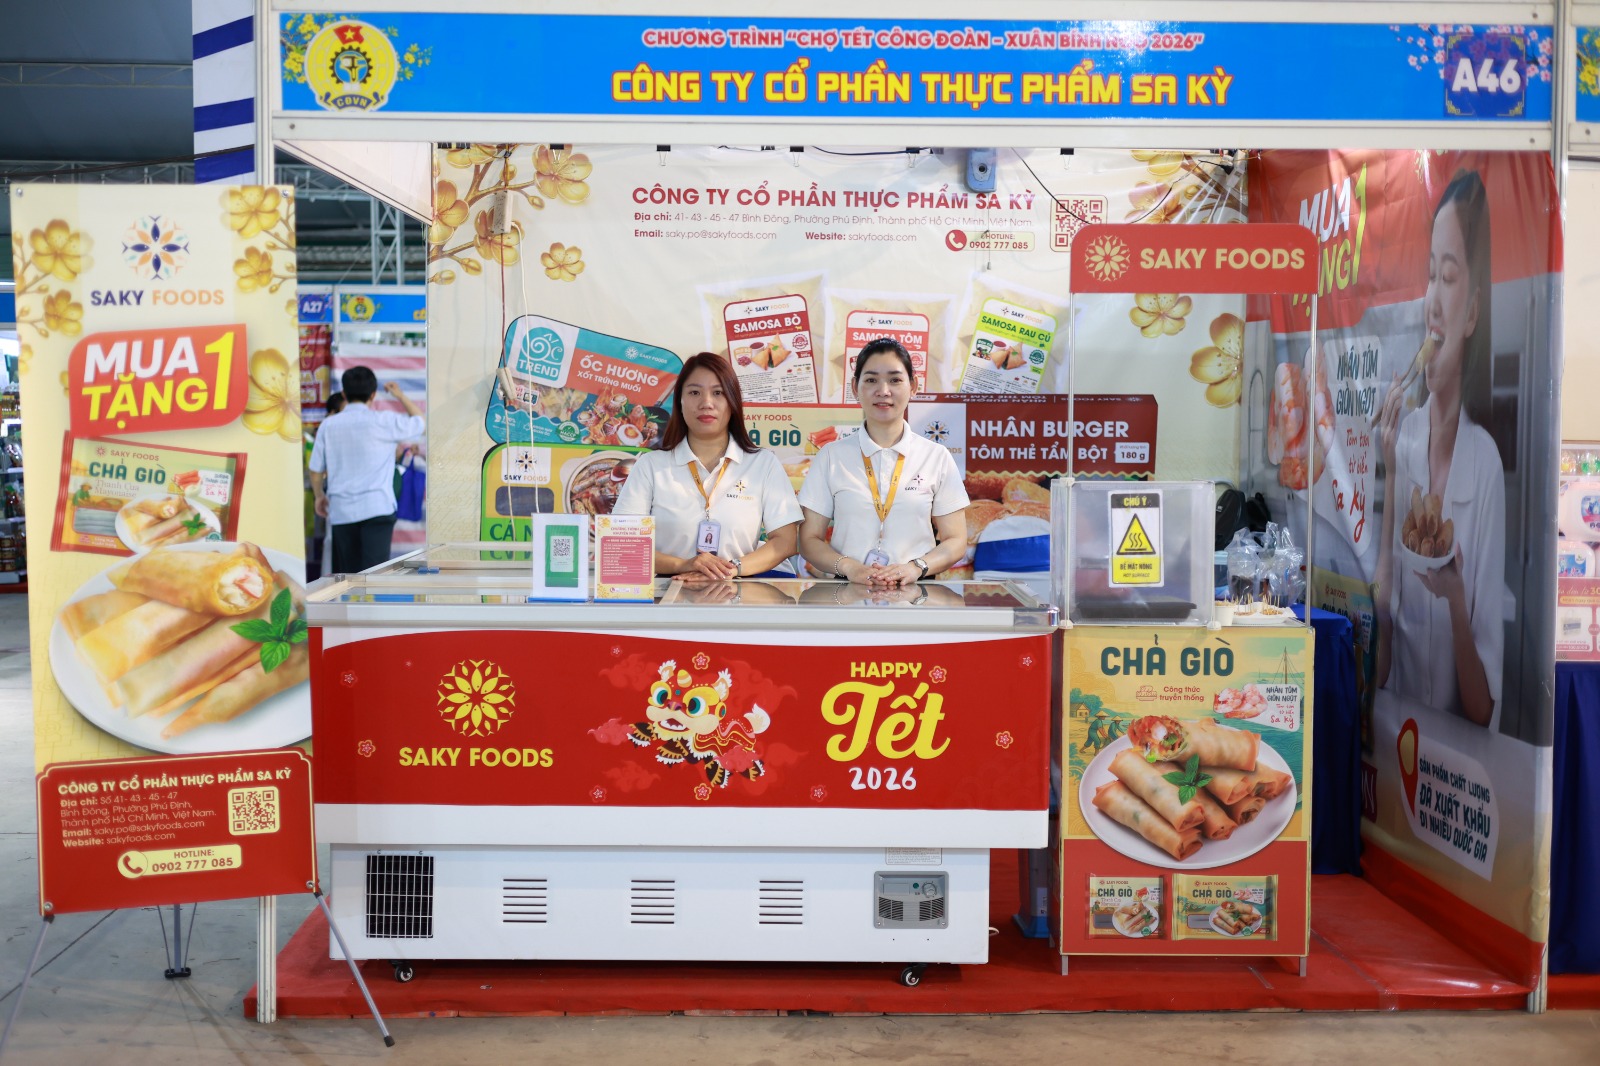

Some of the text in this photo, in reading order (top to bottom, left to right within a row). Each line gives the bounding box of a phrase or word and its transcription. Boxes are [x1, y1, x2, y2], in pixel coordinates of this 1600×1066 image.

[643, 29, 725, 46] CHƯƠNG
[729, 27, 782, 46] TRÌNH
[842, 27, 873, 46] TẾT
[877, 27, 930, 46] CÔNG
[936, 27, 989, 47] ĐOÀN
[1006, 28, 1055, 48] XUÂN
[1059, 28, 1101, 48] BÍNH
[612, 57, 1233, 109] CÔNG TY CỔ PHẦN THỰC PHẨM SA KỲ
[1451, 58, 1521, 94] A46
[632, 180, 1036, 212] CÔNG TY CỔ PHẦN THỰC PHẨM SA KỲ
[634, 212, 651, 223] Địa
[653, 211, 672, 221] chỉ:
[691, 213, 702, 222] 43
[710, 213, 721, 222] 45
[728, 213, 740, 222] 47
[742, 213, 762, 223] Bình
[794, 214, 830, 225] Phường
[832, 214, 850, 224] Phú
[1299, 177, 1351, 243] MUA
[634, 229, 777, 240] Email: saky.po@sakyfoods.com
[1352, 162, 1367, 286] 1
[805, 231, 917, 242] Website: sakyfoods.com
[969, 241, 1029, 250] 0902 777 085
[1140, 248, 1305, 269] SAKY FOODS
[90, 289, 225, 306] SAKY FOODS
[303, 300, 323, 313] A27
[733, 313, 801, 333] SAMOSA BÒ
[981, 315, 1051, 343] SAMOSA RAU CỦ
[899, 332, 923, 344] TÔM
[84, 336, 199, 383] MUA
[518, 358, 559, 378] TREND
[579, 354, 659, 387] ỐC HƯƠNG
[1336, 345, 1360, 381] NHÂN
[204, 331, 235, 411] 1
[577, 370, 642, 393] XỐT TRỨNG MUỐI
[82, 372, 208, 429] TẶNG
[1355, 387, 1377, 423] NGỌT
[769, 423, 802, 447] GIÒ
[970, 416, 1129, 438] NHÂN BURGER
[970, 441, 1108, 463] TÔM THẺ TẨM BỘT
[1120, 451, 1137, 460] 180
[88, 457, 166, 485] CHẢ GIÒ
[1123, 495, 1140, 507] CHÚ
[1332, 479, 1344, 513] Sa
[489, 519, 517, 542] CÁ
[1101, 633, 1235, 677] CHẢ GIÒ
[850, 661, 922, 678] HAPPY
[1159, 693, 1205, 703] truyền thống
[1163, 684, 1201, 695] Công thức
[820, 680, 951, 762] Tết
[399, 746, 554, 768] SAKY FOODS
[58, 781, 99, 795] CÔNG
[101, 781, 116, 792] TY
[119, 774, 140, 791] CỔ
[143, 773, 178, 789] PHẦN
[181, 774, 215, 788] THỰC
[217, 767, 254, 783] PHẨM
[256, 770, 273, 781] SA
[848, 766, 917, 791] 2026
[1419, 754, 1431, 775] SẢN
[1432, 762, 1449, 785] PHẨM
[1449, 774, 1466, 793] CHẤT
[60, 798, 78, 809] Địa
[80, 796, 98, 806] chỉ:
[100, 796, 112, 805] Số
[130, 794, 141, 802] 43
[148, 792, 160, 801] 45
[167, 791, 178, 800] 47
[60, 808, 80, 818] Bình
[82, 807, 110, 818] Đông,
[112, 804, 149, 814] Phường
[150, 801, 168, 811] Phú
[1419, 783, 1491, 839] ĐÃ XUẤT KHẨU
[61, 817, 90, 828] Thành
[91, 815, 111, 827] phố
[112, 814, 126, 824] Hồ
[127, 814, 144, 823] Chí
[172, 809, 190, 820] Việt
[192, 808, 217, 818] Nam.
[62, 820, 205, 838] Email: saky.po@sakyfoods.com
[62, 831, 176, 848] Website: sakyfoods.com
[1420, 809, 1488, 863] ĐI NHIỀU QUỐC GIA
[152, 857, 234, 872] 0902 777 085
[173, 849, 215, 859] HOTLINE:
[1192, 886, 1232, 898] CHẢ GIÒ
